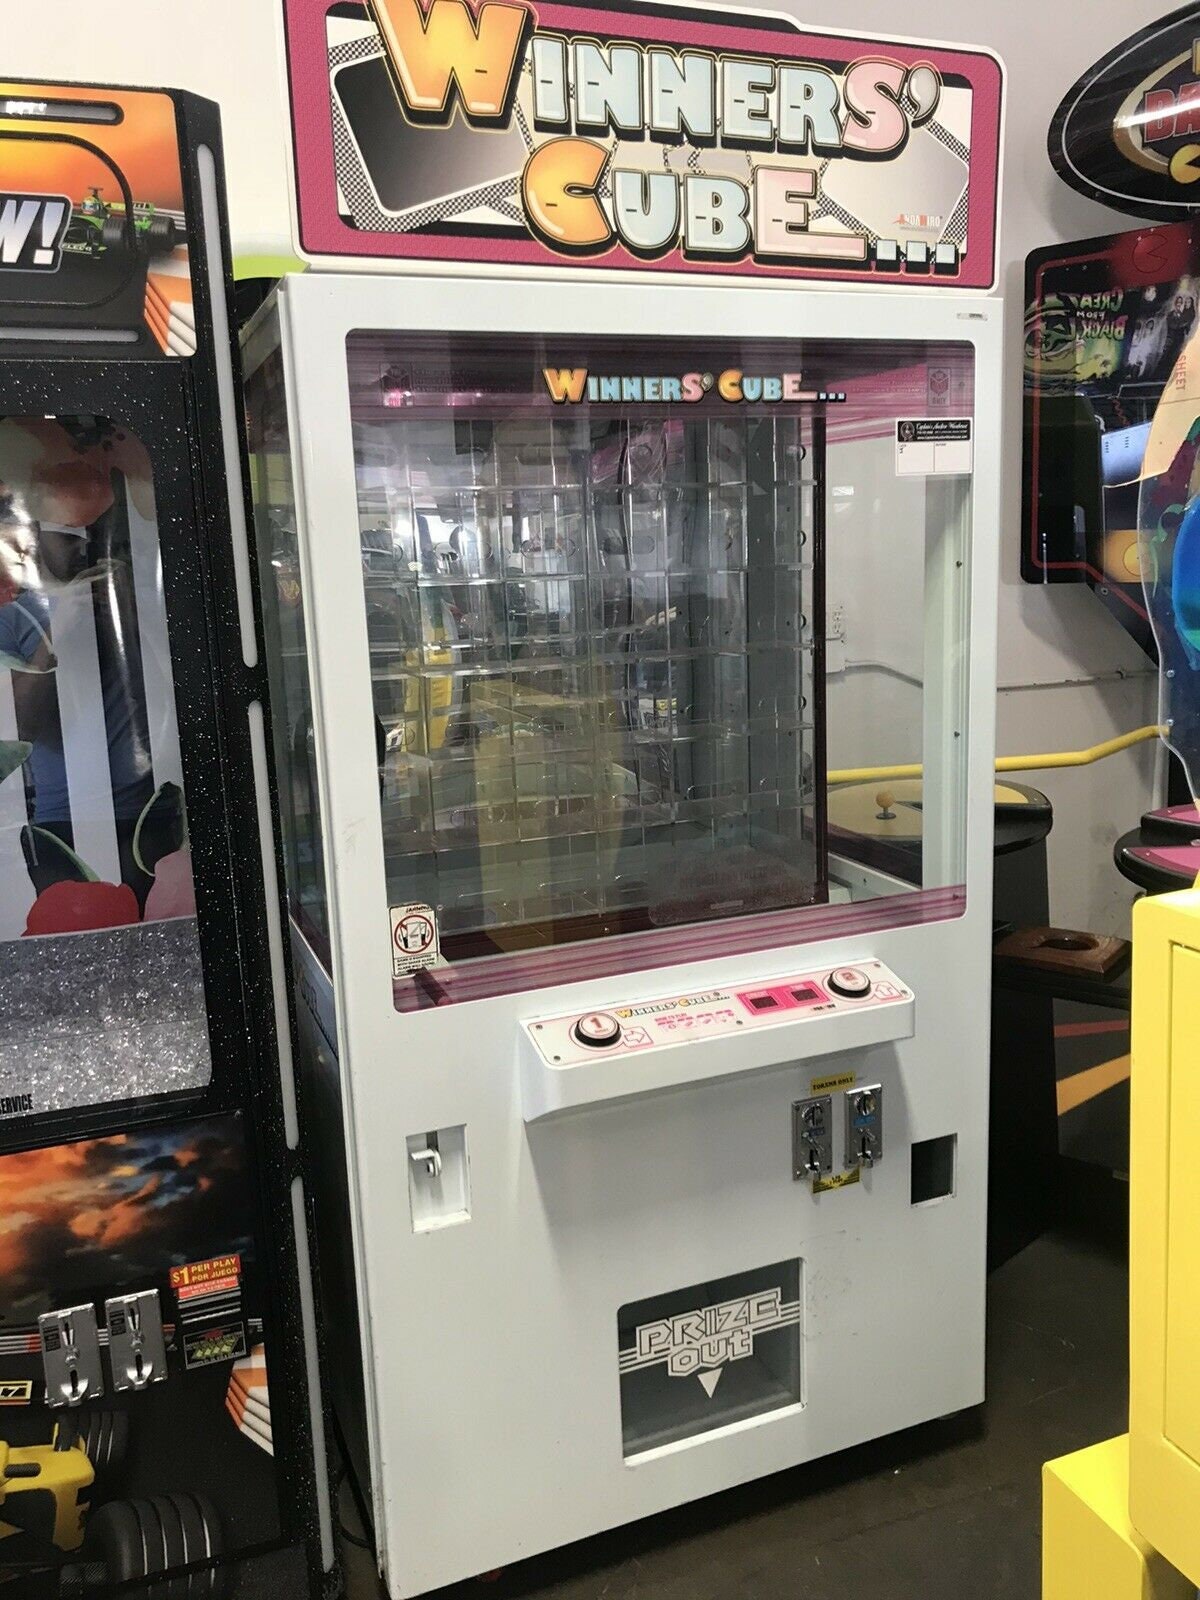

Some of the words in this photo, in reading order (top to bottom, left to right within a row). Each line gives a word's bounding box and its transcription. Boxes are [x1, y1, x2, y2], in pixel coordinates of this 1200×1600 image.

[369, 0, 943, 162] WINNERS'
[542, 367, 714, 404] WINNERS'
[0, 1094, 33, 1114] ERVICE
[172, 1267, 190, 1286] $1
[191, 1260, 211, 1273] PER
[212, 1256, 237, 1269] PLAY
[191, 1271, 210, 1284] POR
[210, 1266, 239, 1279] JUEGO
[636, 1287, 782, 1360] PRIZE
